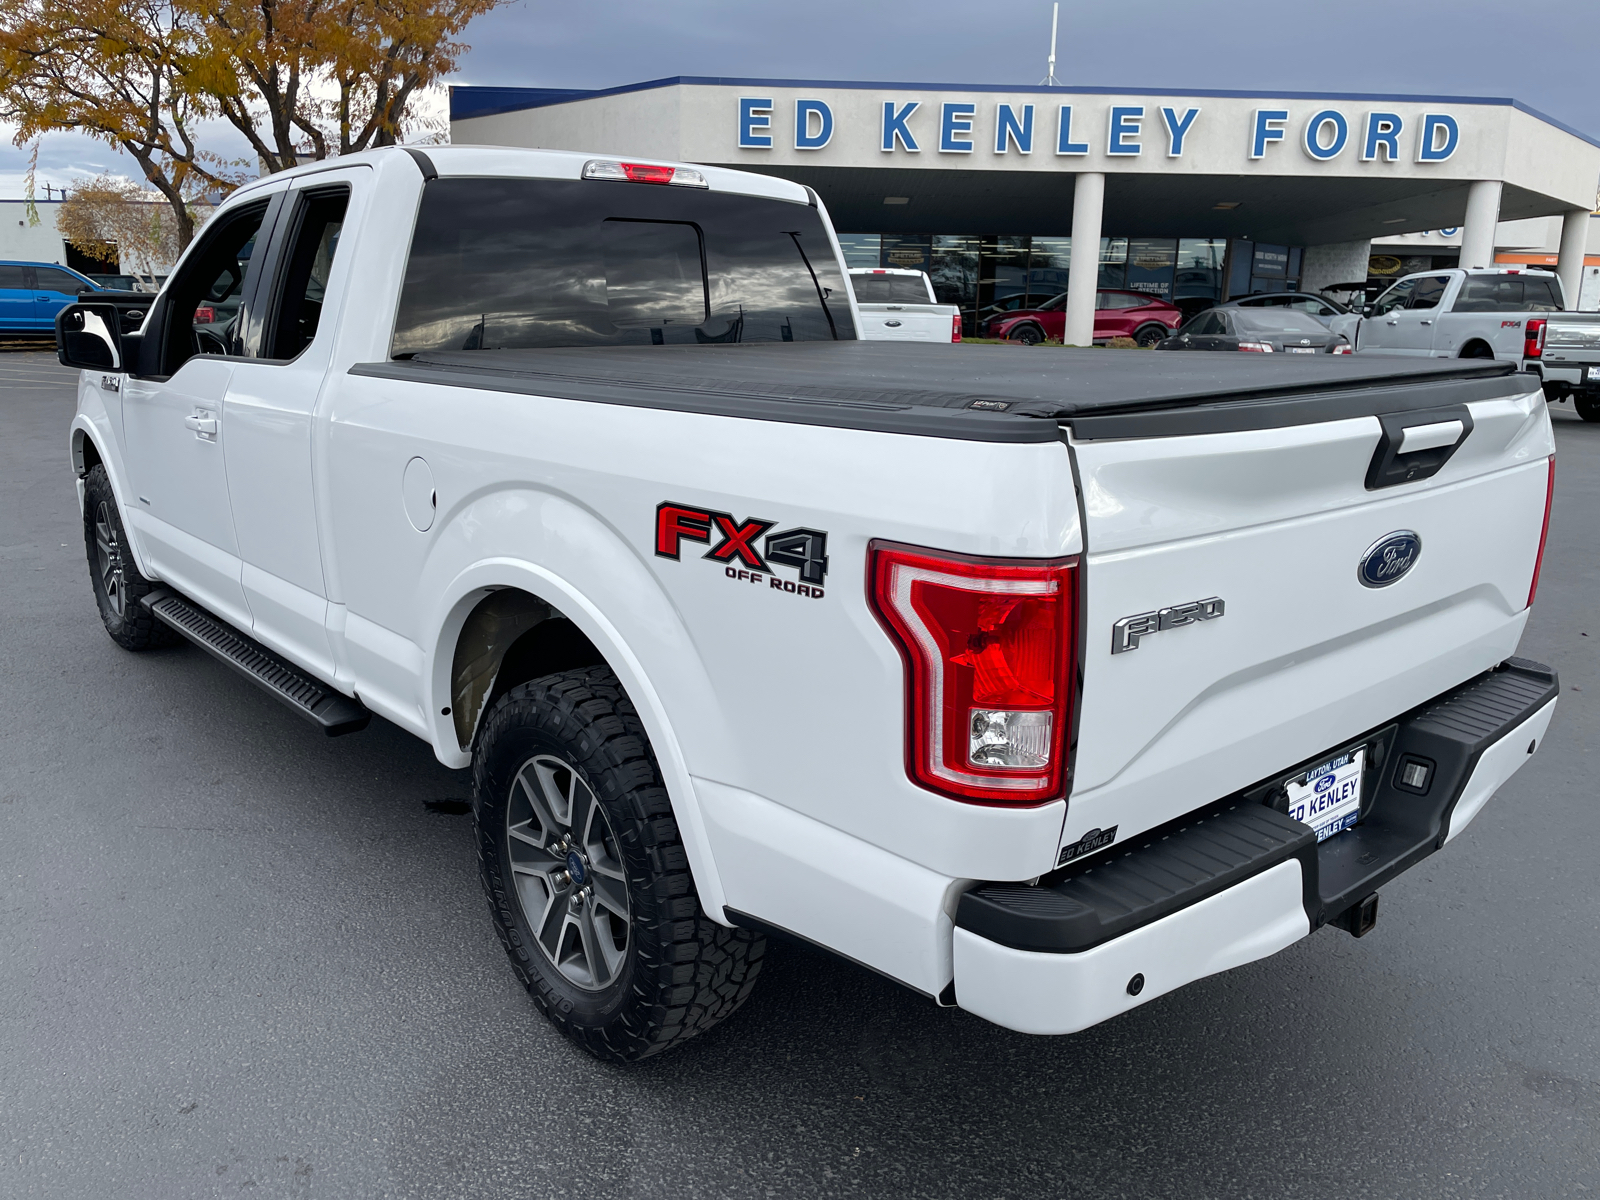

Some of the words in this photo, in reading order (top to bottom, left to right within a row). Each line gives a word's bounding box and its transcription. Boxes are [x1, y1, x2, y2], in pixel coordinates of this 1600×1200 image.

[738, 97, 834, 150] ED
[881, 101, 1202, 158] KENLEY
[1248, 108, 1460, 163] FORD
[1500, 320, 1522, 329] FX4
[654, 499, 830, 588] FX4
[725, 566, 763, 584] OFF
[769, 576, 825, 600] ROAD
[1306, 762, 1332, 782] LAYTON,
[1333, 754, 1349, 769] UTAH
[1309, 778, 1358, 817] KENLEY
[1060, 848, 1075, 862] ED
[1076, 830, 1117, 855] KENLEY
[1314, 818, 1344, 841] ENLEY
[527, 965, 575, 1015] OPEN
